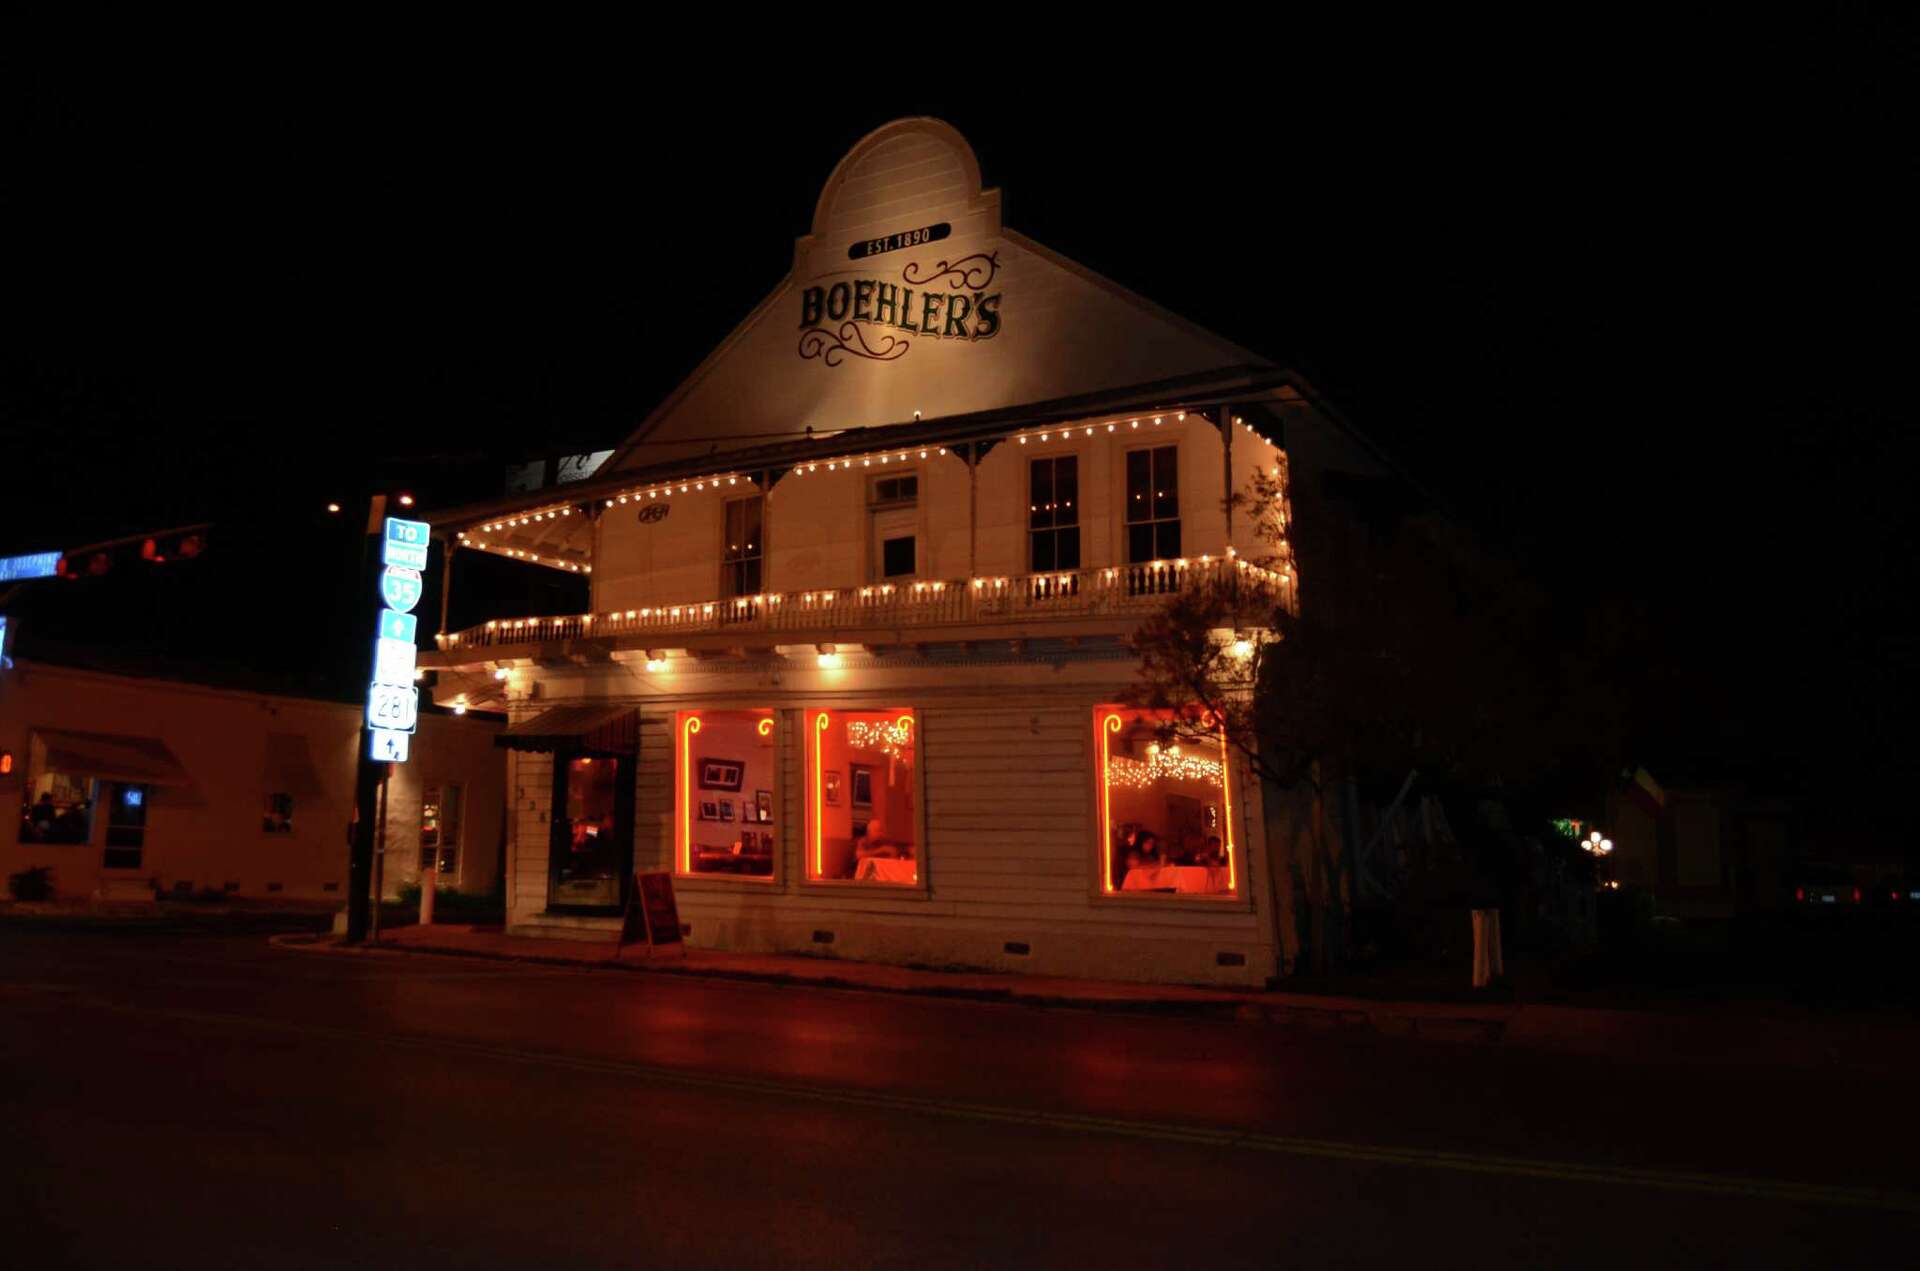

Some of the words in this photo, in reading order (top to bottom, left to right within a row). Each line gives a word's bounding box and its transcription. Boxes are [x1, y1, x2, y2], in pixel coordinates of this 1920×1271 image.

[867, 239, 894, 256] EST.
[896, 228, 931, 249] 1890
[799, 279, 1003, 342] BOEHLER'S
[396, 525, 418, 541] TO
[389, 580, 416, 604] 35
[377, 693, 410, 719] 281
